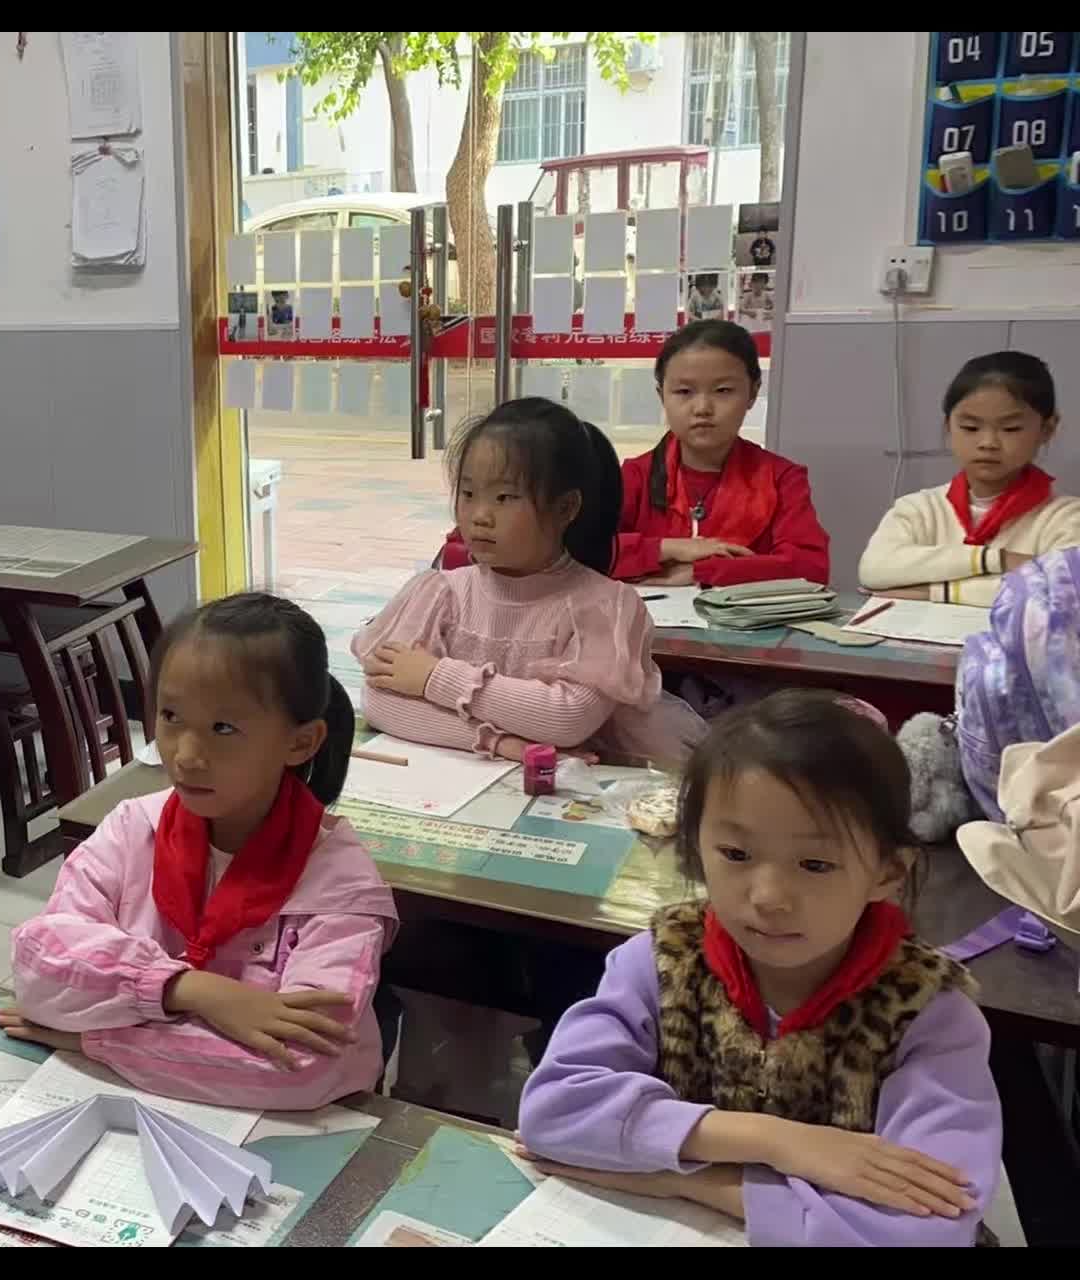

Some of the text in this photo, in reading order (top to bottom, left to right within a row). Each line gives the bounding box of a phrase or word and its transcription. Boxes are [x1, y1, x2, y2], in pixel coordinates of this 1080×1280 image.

[948, 36, 980, 63] 04
[1020, 32, 1054, 57] 05
[943, 125, 975, 151] 07
[1013, 120, 1045, 145] 08
[937, 211, 969, 233] 10
[1006, 209, 1034, 231] 11
